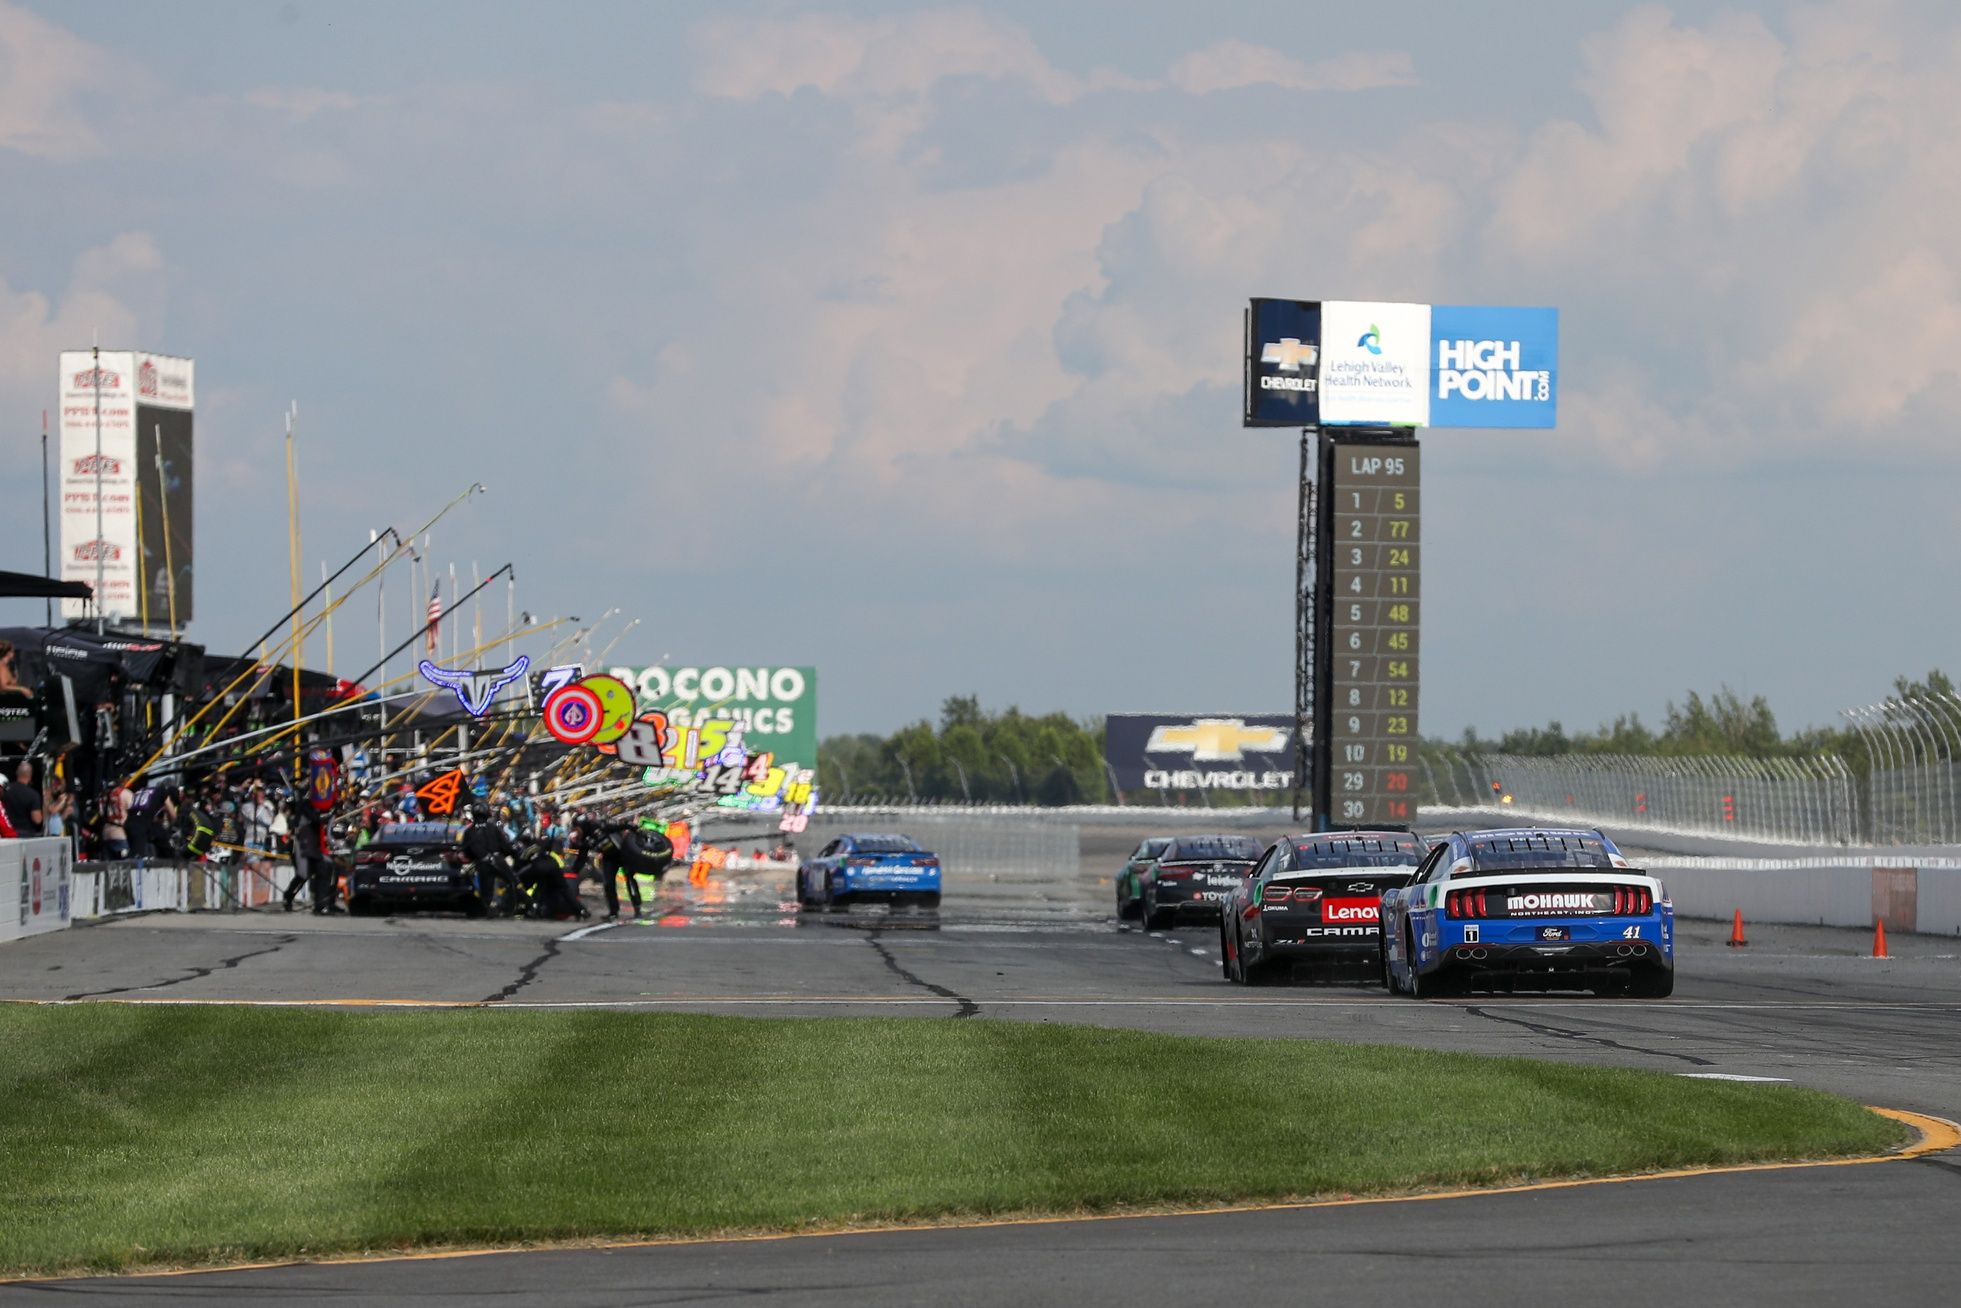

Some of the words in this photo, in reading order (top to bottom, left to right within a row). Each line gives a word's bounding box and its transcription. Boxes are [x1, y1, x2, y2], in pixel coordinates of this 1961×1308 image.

[1439, 340, 1520, 370] HIGH
[1331, 360, 1370, 374] Lehigh
[1371, 361, 1404, 374] Valley
[1261, 376, 1317, 392] CHEVROLET
[1326, 375, 1361, 386] Health
[1364, 376, 1412, 388] Network
[1439, 370, 1539, 400] POINT
[1352, 458, 1381, 475] LAP
[1385, 458, 1404, 475] 95
[1353, 493, 1360, 508] 1
[1394, 493, 1404, 509] 5
[1352, 520, 1362, 537] 2
[1389, 521, 1409, 538] 77
[1352, 549, 1362, 565] 3
[1389, 550, 1409, 565] 24
[1351, 576, 1361, 593] 4
[1390, 577, 1408, 593] 11
[1351, 605, 1361, 621] 5
[1389, 605, 1409, 622] 48
[1349, 632, 1361, 648] 6
[1388, 633, 1408, 649] 45
[1350, 661, 1360, 677] 7
[1389, 661, 1408, 677] 54
[1349, 688, 1360, 706] 8
[1388, 689, 1408, 706] 12
[1349, 717, 1360, 733] 9
[1388, 717, 1408, 733] 23
[698, 719, 737, 761] 5
[1344, 745, 1365, 762] 10
[697, 766, 743, 794] 14
[1144, 770, 1295, 790] CHEVROLET
[1343, 772, 1364, 790] 29
[1343, 801, 1364, 818] 30
[1507, 893, 1595, 910] MOHAWK
[1328, 904, 1380, 920] Lenov
[1306, 927, 1380, 937] CAMA
[1542, 927, 1562, 937] Ford
[1622, 926, 1643, 939] 41
